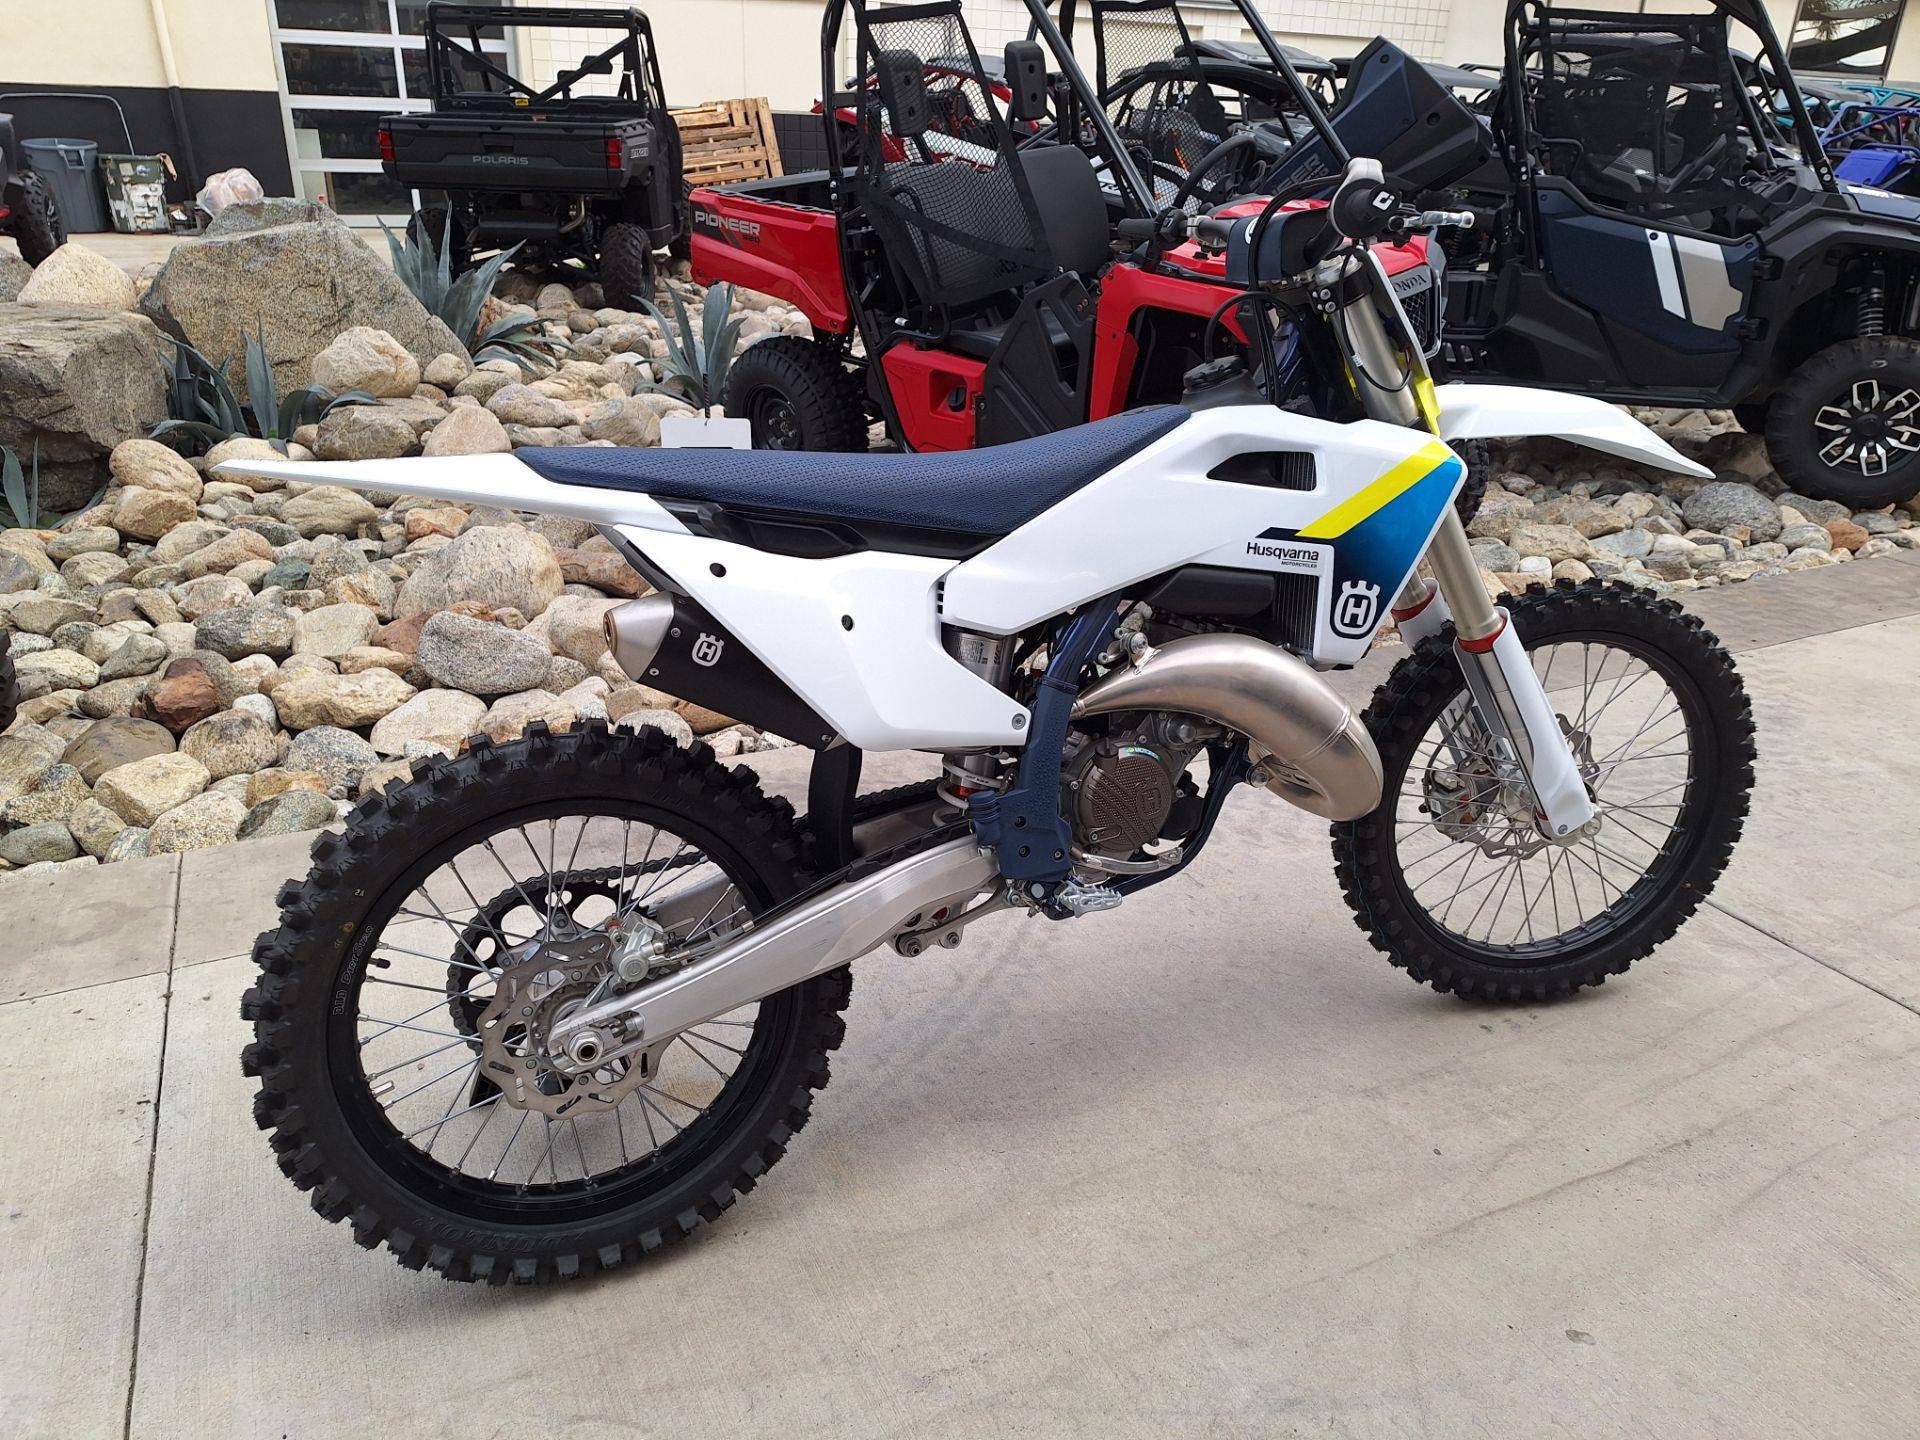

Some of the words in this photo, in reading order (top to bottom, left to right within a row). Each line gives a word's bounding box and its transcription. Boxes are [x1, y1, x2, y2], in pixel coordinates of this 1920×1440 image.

[472, 155, 529, 165] POLARIS
[694, 210, 760, 236] PIONEER
[1393, 274, 1427, 292] ONDA
[1246, 541, 1319, 561] Husqvarna
[1281, 560, 1318, 568] MOTORCYCLES
